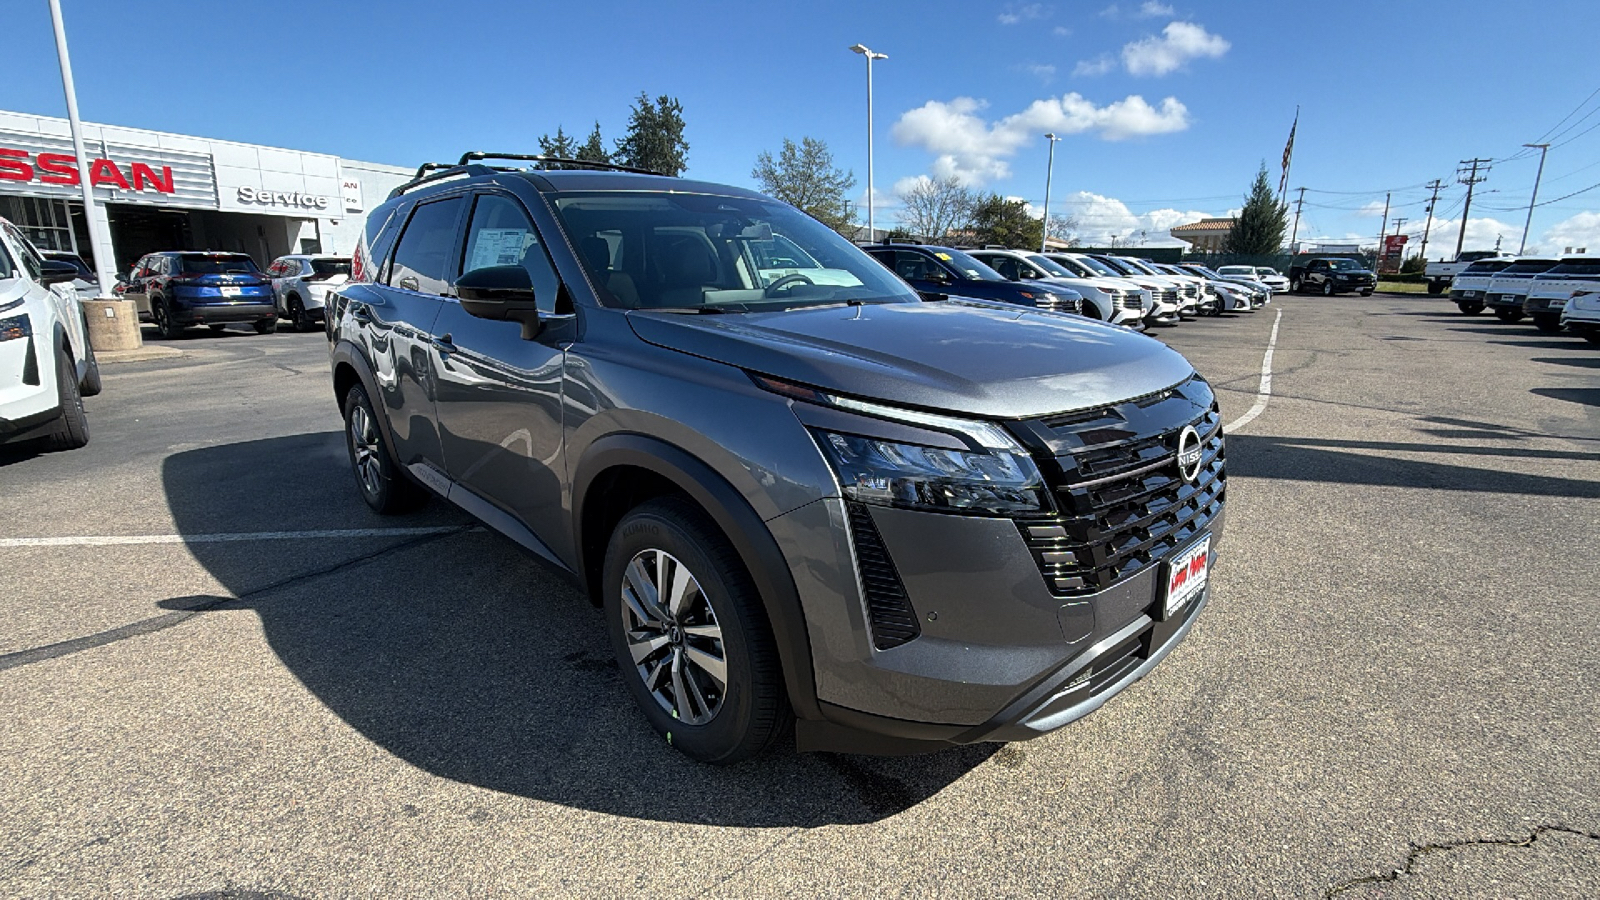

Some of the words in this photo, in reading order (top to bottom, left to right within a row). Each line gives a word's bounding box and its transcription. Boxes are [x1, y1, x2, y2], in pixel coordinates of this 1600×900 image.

[237, 185, 329, 210] Service
[1178, 450, 1202, 467] NISS
[622, 523, 660, 538] KUMHO
